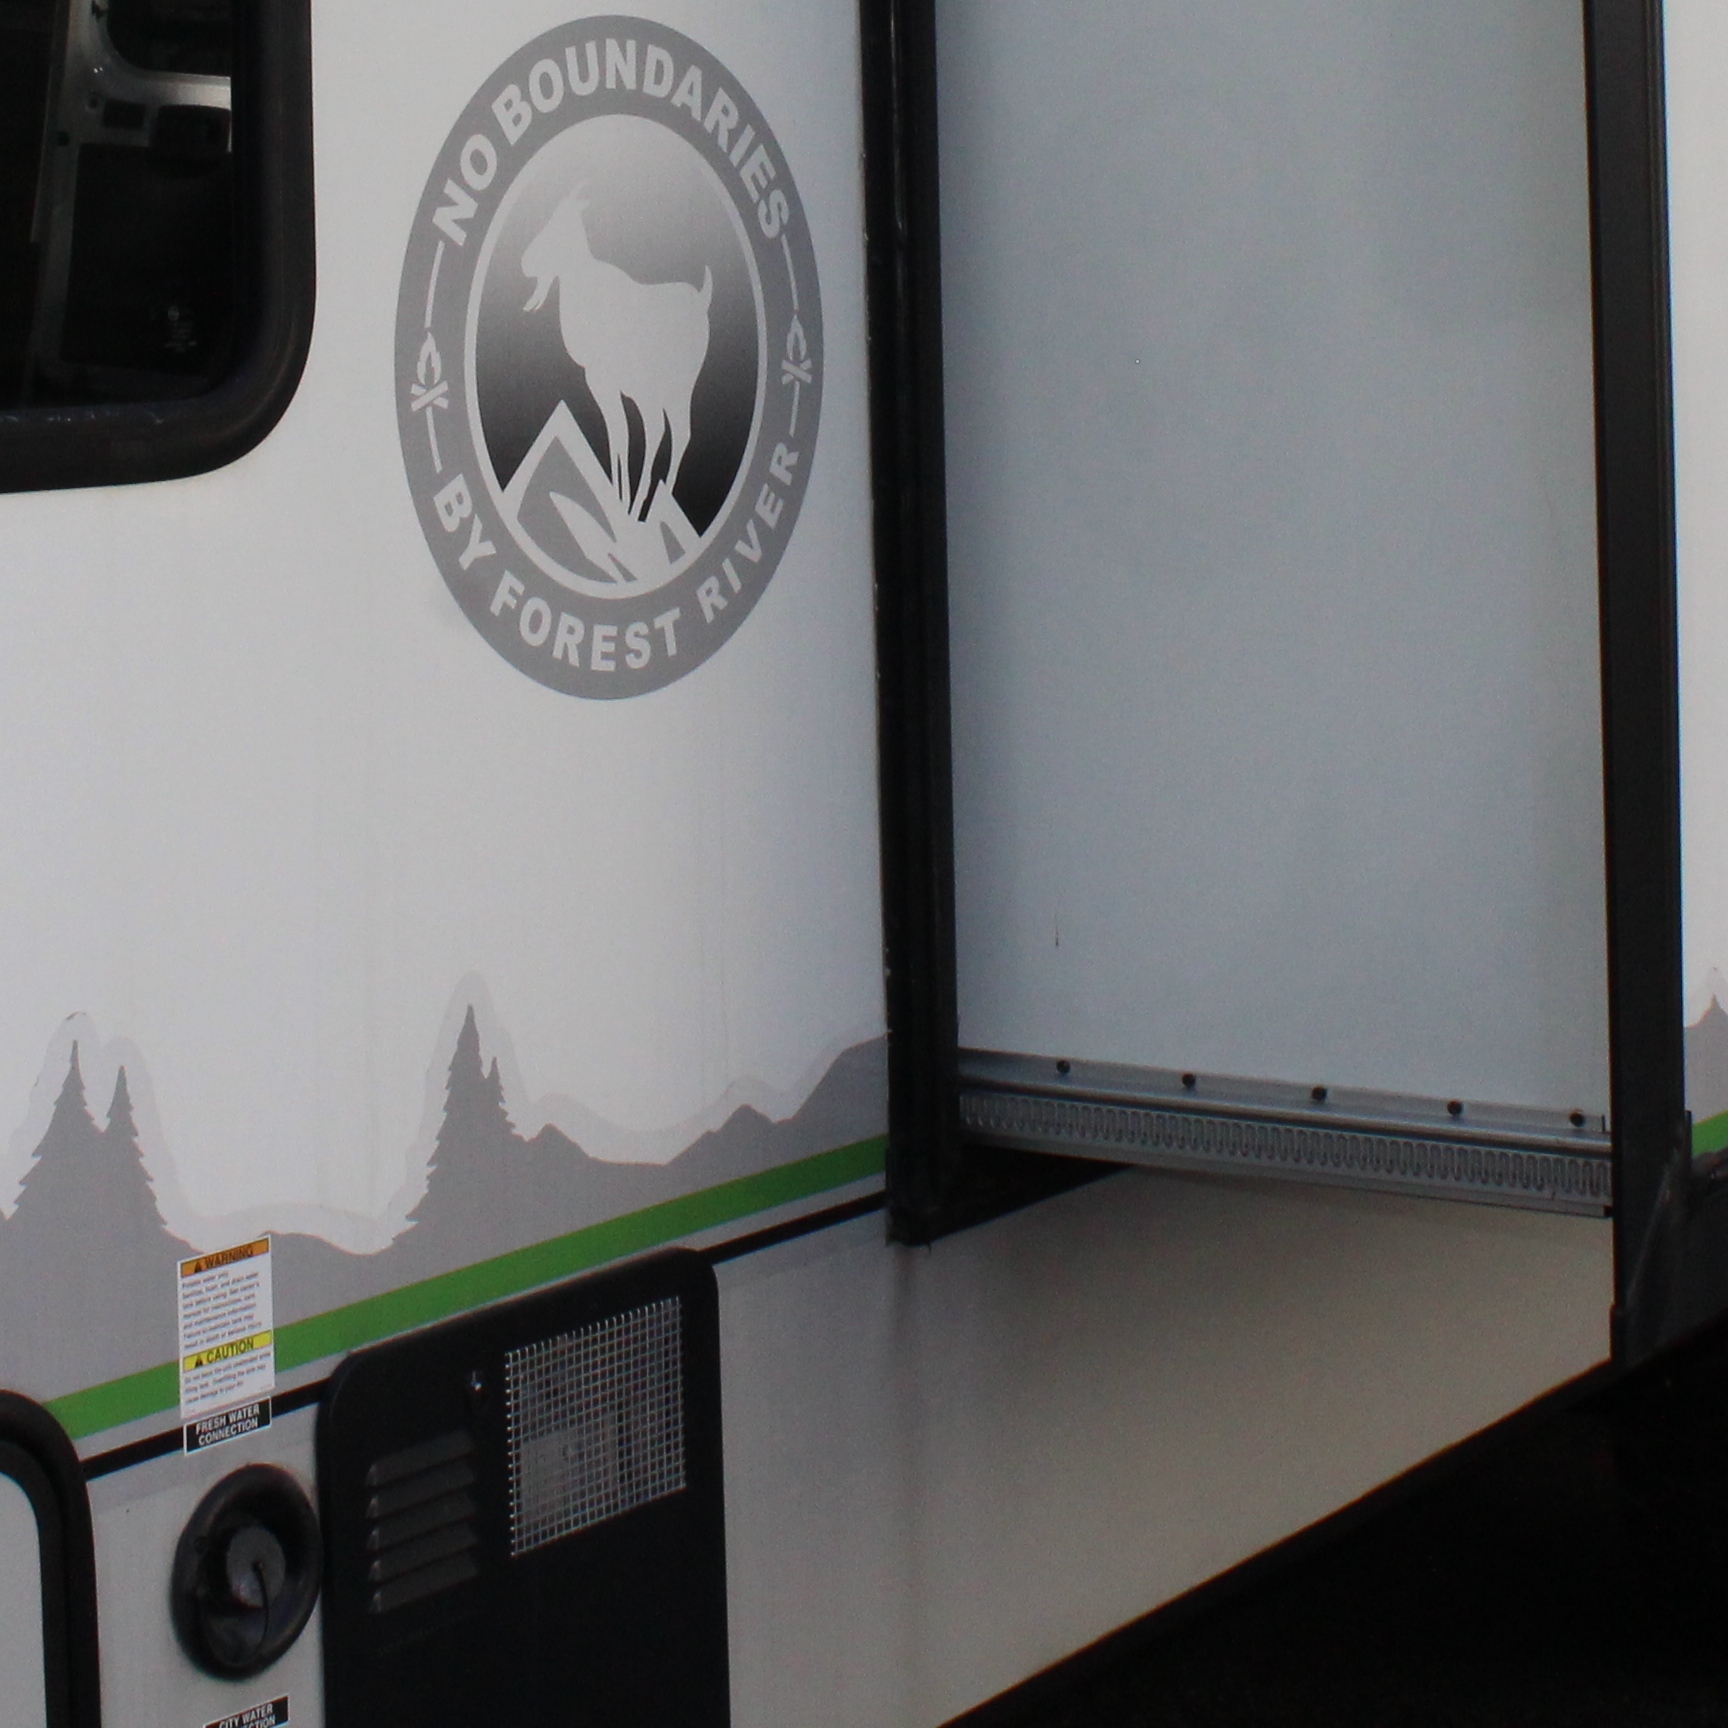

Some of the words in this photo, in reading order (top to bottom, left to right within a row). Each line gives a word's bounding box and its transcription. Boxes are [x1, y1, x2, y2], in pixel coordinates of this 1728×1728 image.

[431, 132, 499, 247] NO
[490, 37, 791, 240] BOUNDARIES
[432, 473, 497, 571] BY
[488, 569, 682, 673] FOREST
[696, 442, 799, 624] RIVER
[204, 1244, 254, 1269] WARNING
[206, 1336, 255, 1364] CAUTION
[195, 1414, 227, 1436] FRESH
[228, 1403, 261, 1425] WATER
[198, 1416, 259, 1446] CONNECTION
[242, 1702, 273, 1725] WATER
